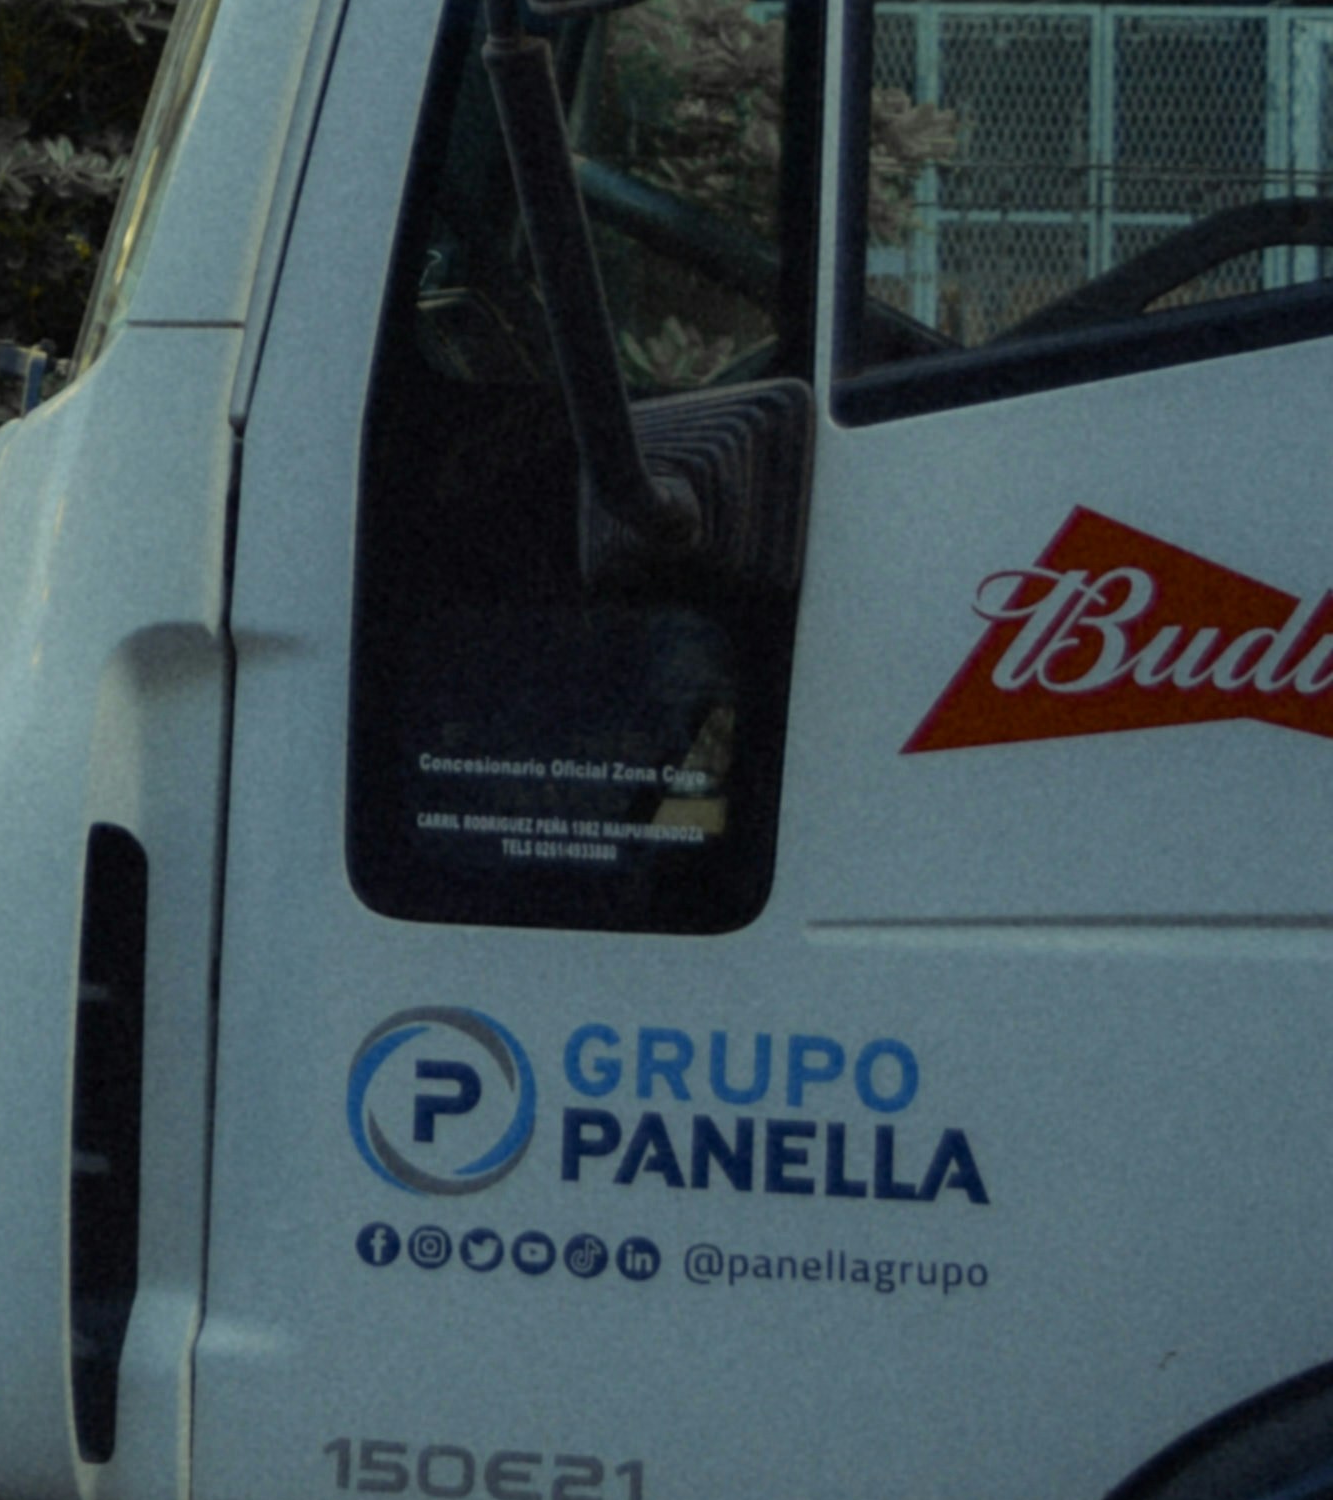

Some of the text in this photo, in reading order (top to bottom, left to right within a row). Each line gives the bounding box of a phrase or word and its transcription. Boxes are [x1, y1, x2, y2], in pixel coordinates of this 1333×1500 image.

[419, 753, 545, 778] Concesionario
[551, 758, 608, 780] Oficial
[612, 762, 657, 783] Zona
[563, 1022, 921, 1113] GRUPO
[560, 1106, 991, 1205] PANELLA
[683, 1242, 990, 1295] @panellagrupo
